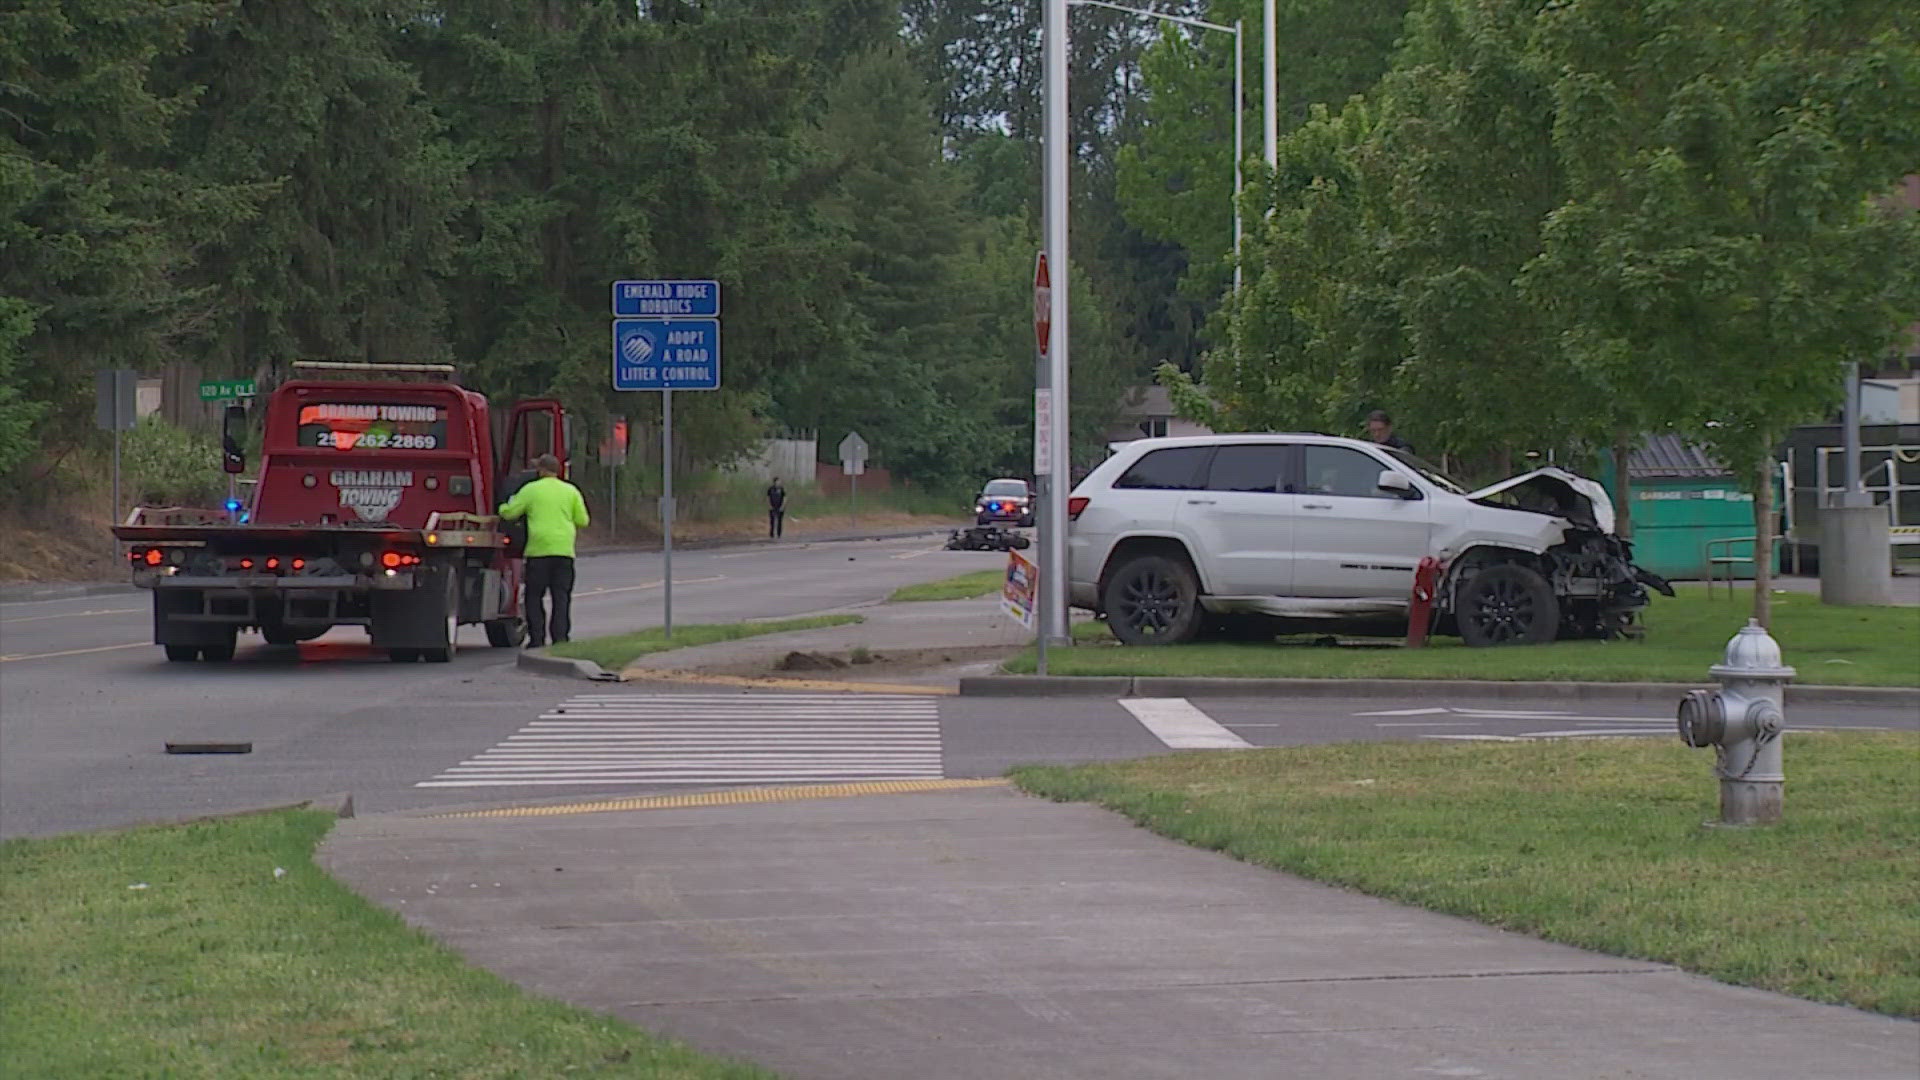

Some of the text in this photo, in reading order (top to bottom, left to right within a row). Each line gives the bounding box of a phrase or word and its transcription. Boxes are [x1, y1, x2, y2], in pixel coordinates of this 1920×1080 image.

[623, 284, 708, 299] EMERALD RIDGE
[640, 299, 692, 313] ROBOTICS
[667, 331, 704, 345] ADOPT
[663, 349, 709, 362] A ROAD
[622, 367, 710, 381] LITTER CONTROL
[318, 404, 437, 422] GRAHAM TOWING
[316, 432, 437, 449] 25262-2869
[330, 471, 413, 486] GRAHAM
[339, 487, 402, 507] TOWING
